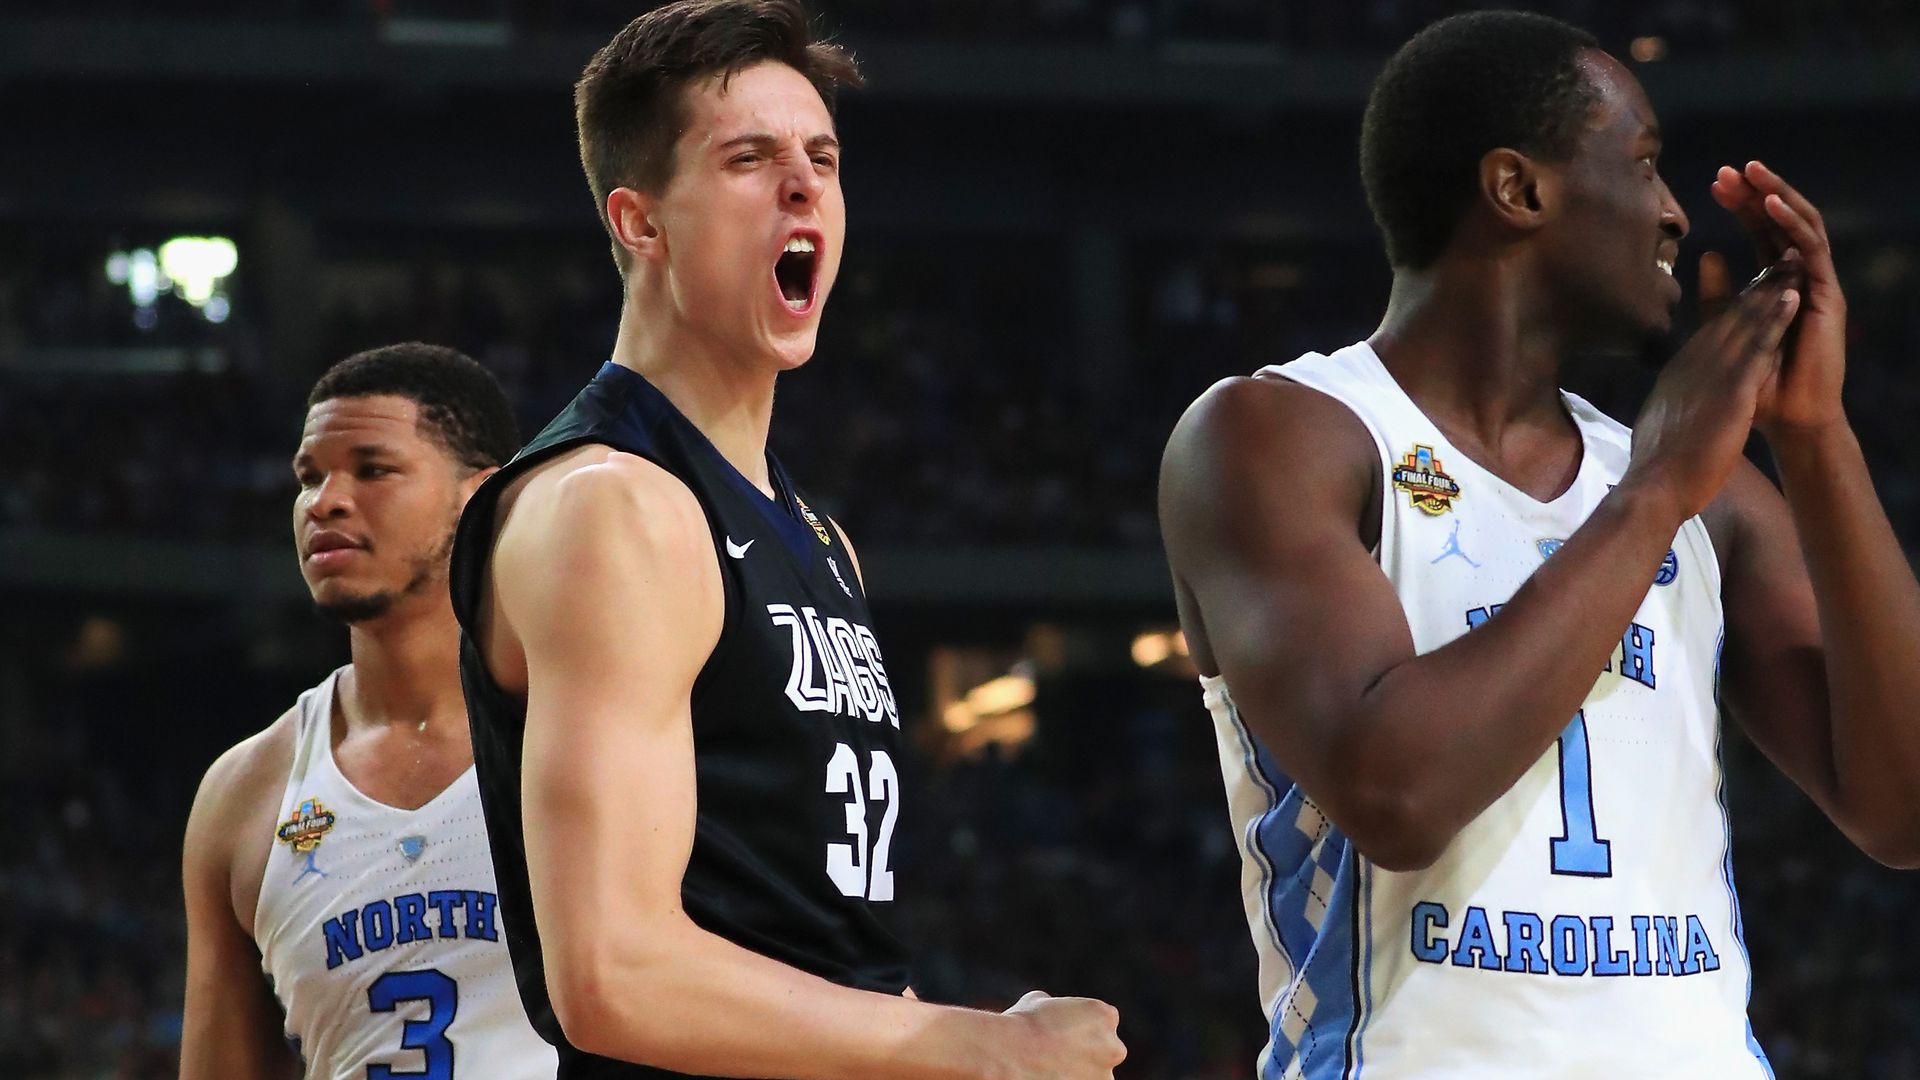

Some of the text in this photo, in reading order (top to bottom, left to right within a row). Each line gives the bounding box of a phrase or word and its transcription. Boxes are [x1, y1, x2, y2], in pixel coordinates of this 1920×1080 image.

[1401, 470, 1427, 484] FINAL
[1428, 475, 1452, 489] FOUR
[767, 603, 900, 730] ZAGS
[825, 742, 900, 902] 32
[1550, 708, 1612, 878] 1
[322, 890, 498, 970] NORTH
[1410, 901, 1721, 977] CAROLINA
[366, 968, 458, 1080] 3
